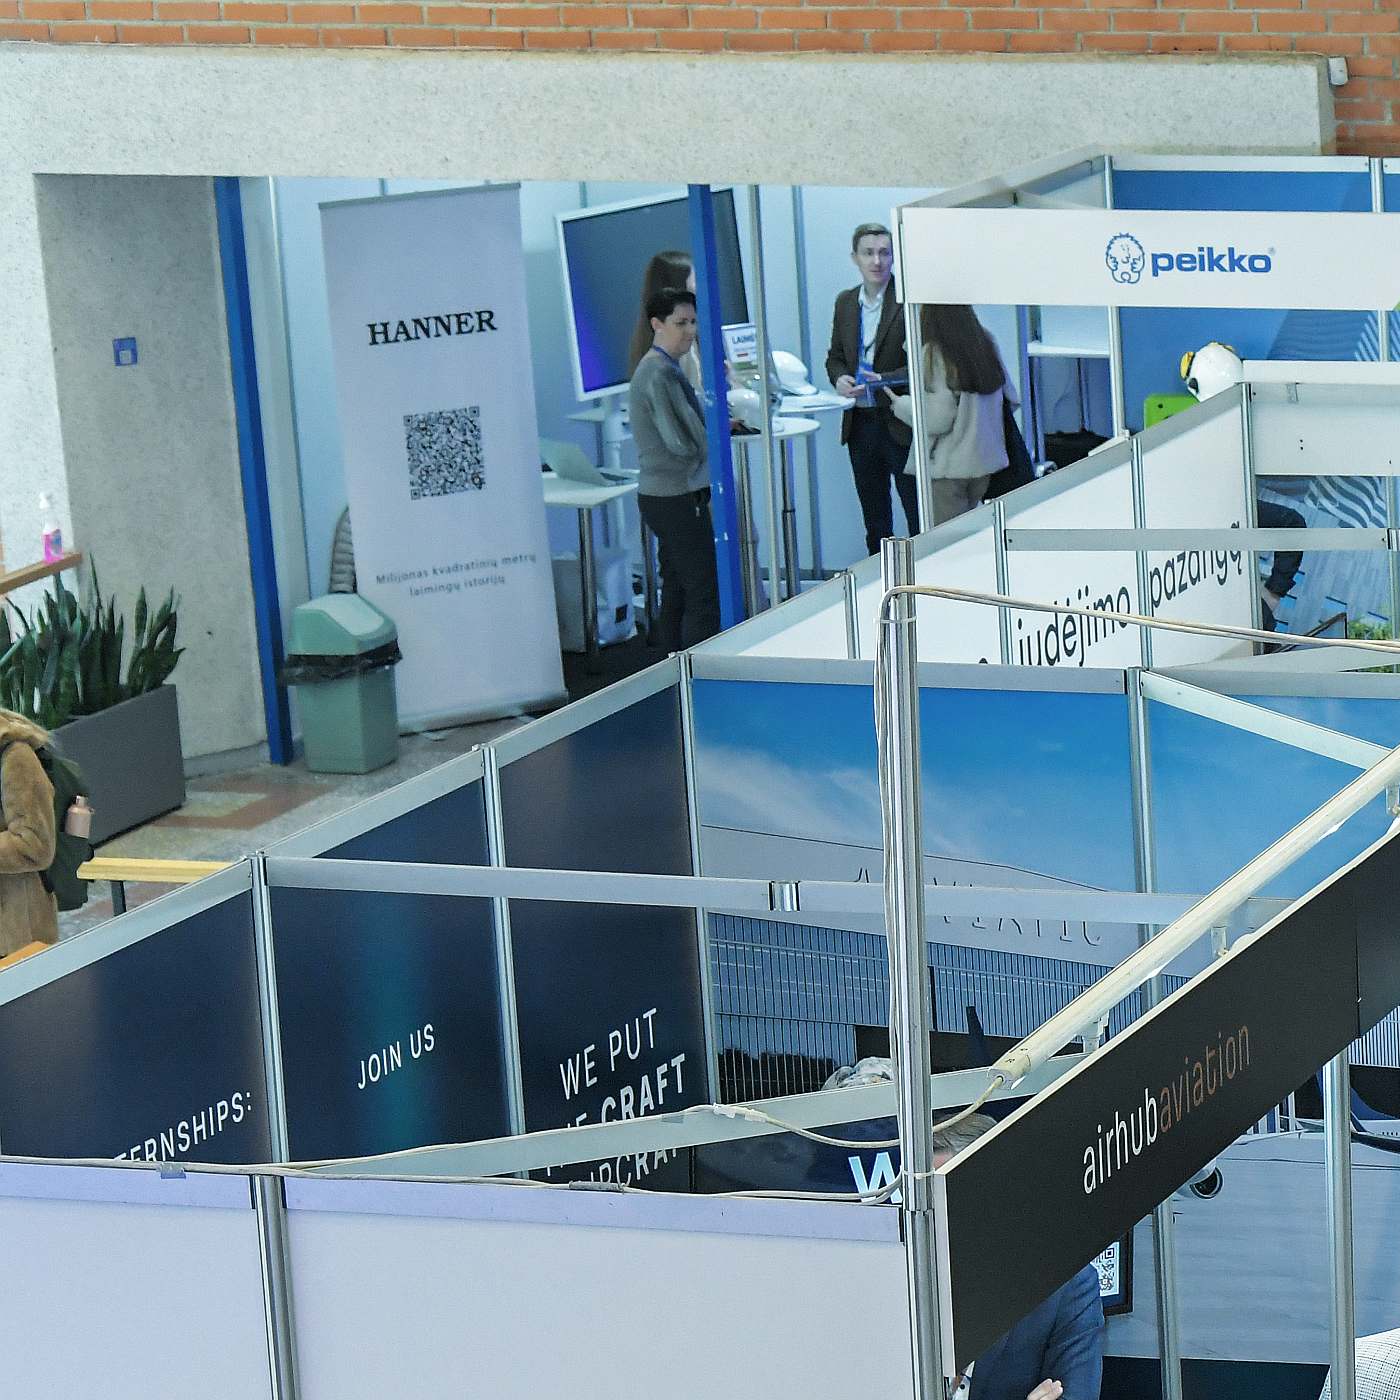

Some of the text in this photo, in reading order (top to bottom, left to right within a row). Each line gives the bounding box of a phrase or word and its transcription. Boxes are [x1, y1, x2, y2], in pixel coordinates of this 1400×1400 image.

[1151, 246, 1272, 277] peikko
[367, 309, 498, 346] HANNER
[357, 1022, 437, 1091] JOIN US
[559, 1007, 658, 1101] WE PUT
[601, 1052, 686, 1124] CRAFT
